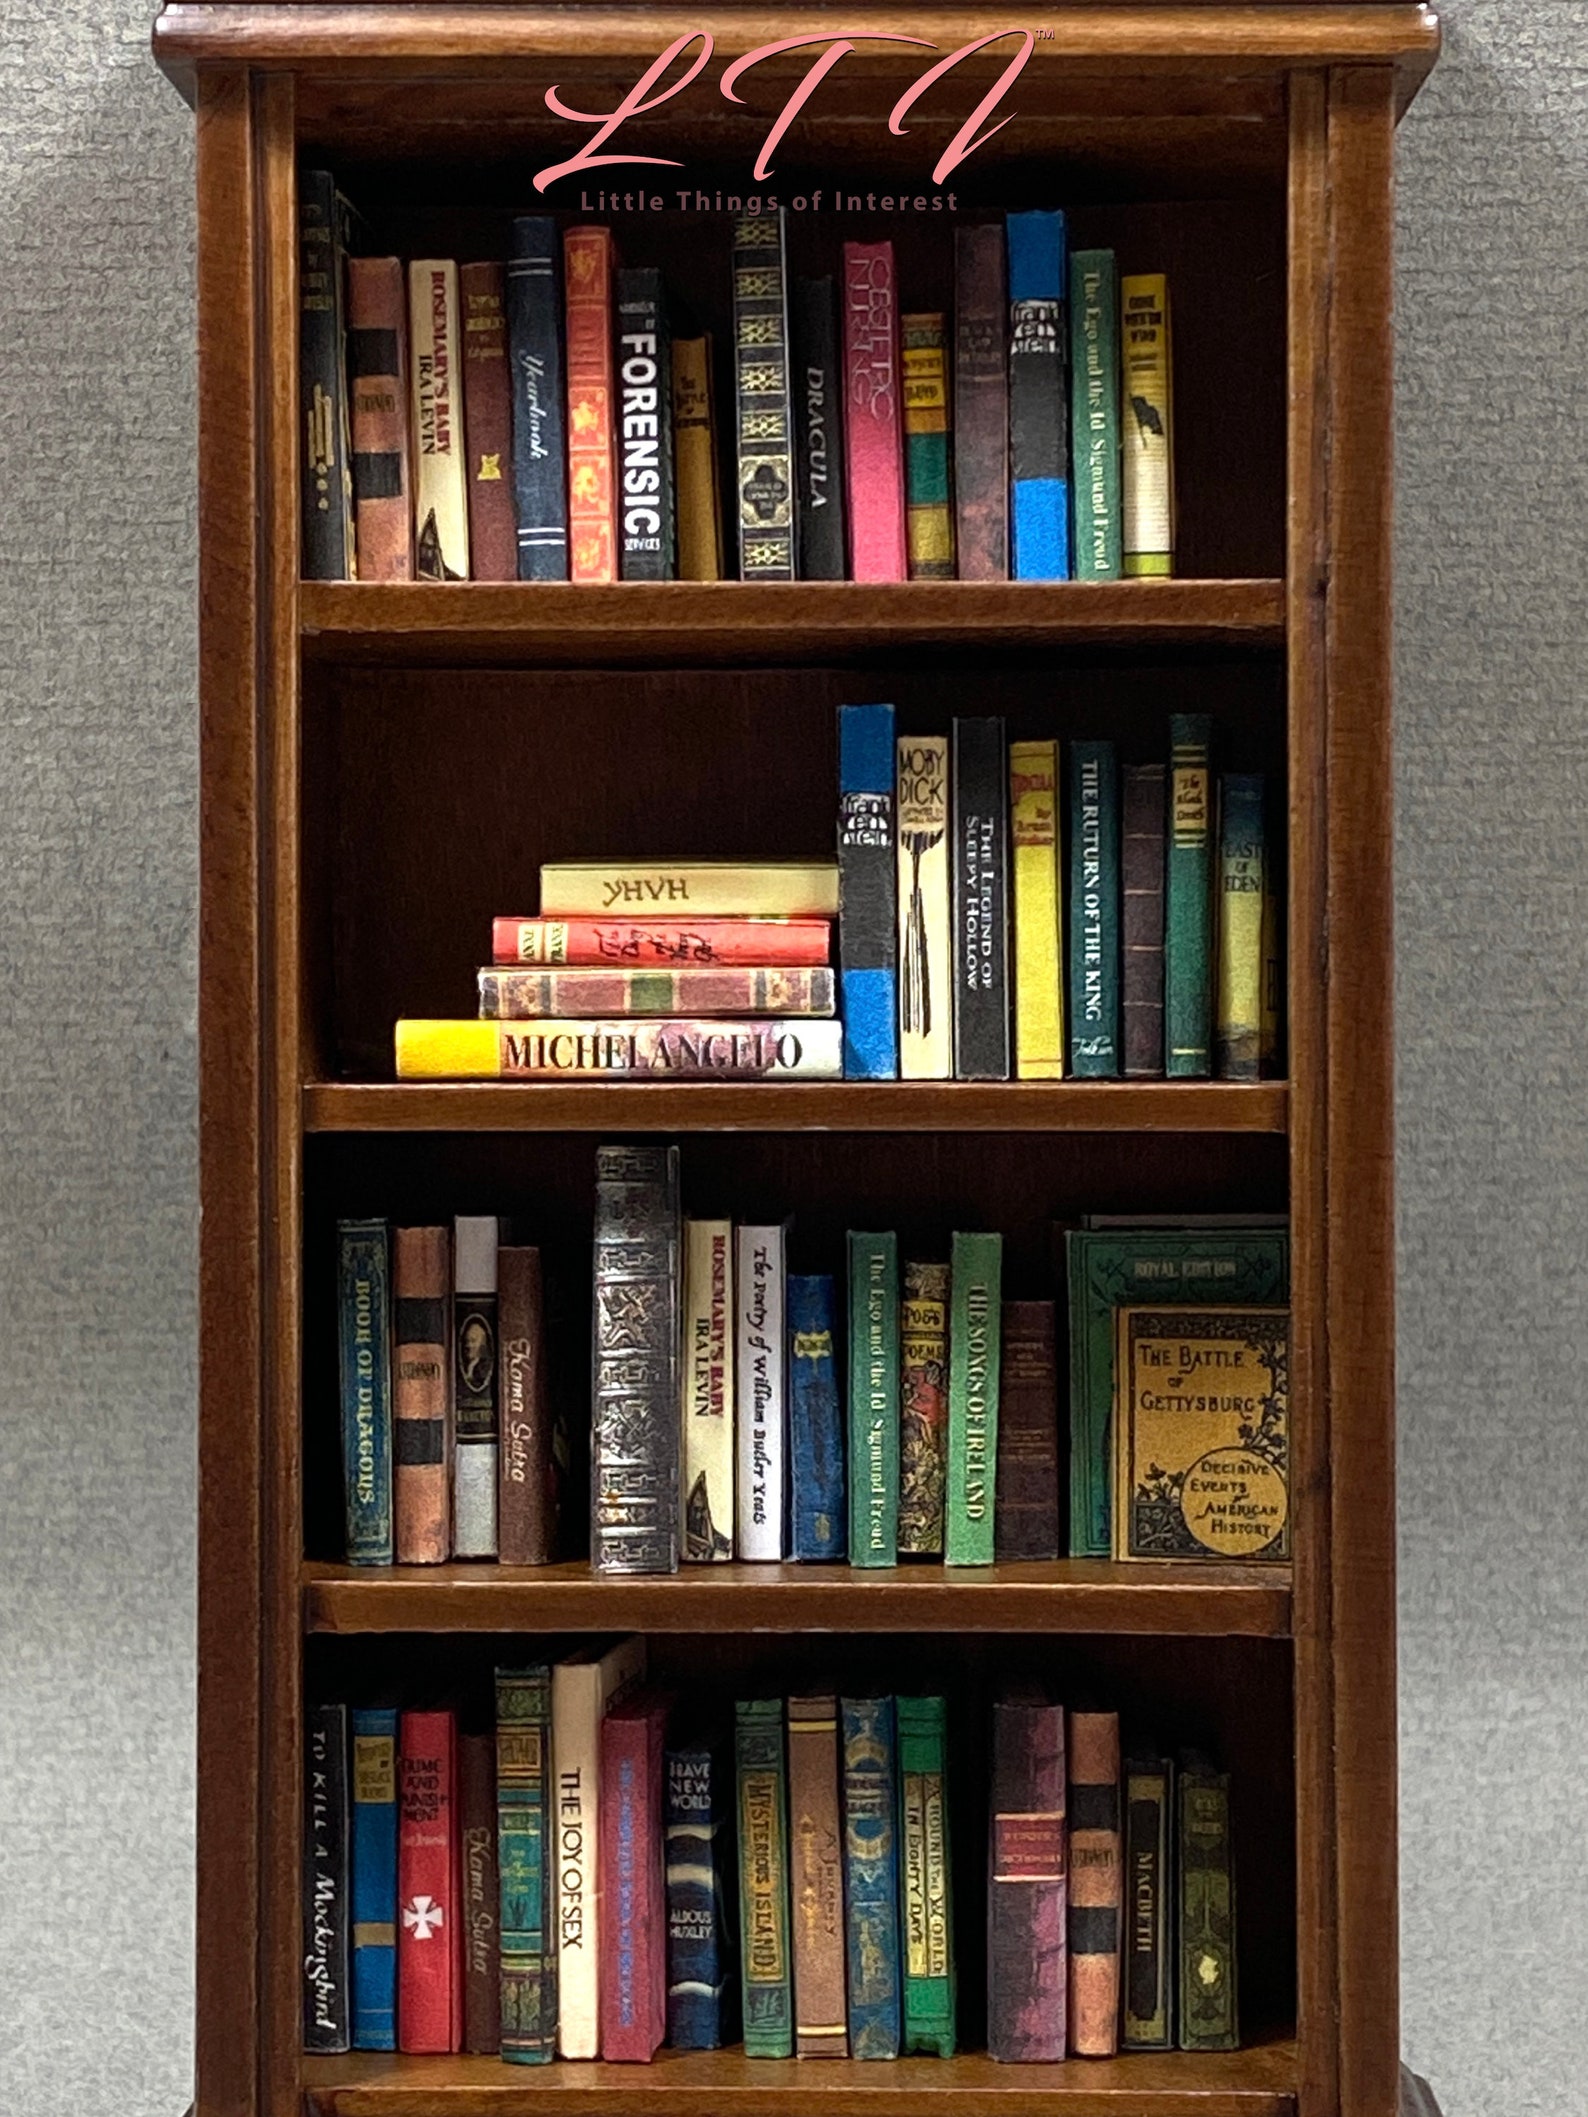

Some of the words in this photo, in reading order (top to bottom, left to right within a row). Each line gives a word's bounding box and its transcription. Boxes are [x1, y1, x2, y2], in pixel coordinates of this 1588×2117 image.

[1084, 272, 1100, 302] The
[1083, 307, 1100, 340] Ego
[418, 355, 432, 389] IRA
[1087, 344, 1103, 375] and
[1088, 380, 1104, 406] the
[420, 395, 435, 455] LEVIN
[621, 334, 661, 535] FORENSIC
[806, 367, 829, 509] DRACULA
[1090, 411, 1105, 430] Id
[1089, 438, 1110, 514] Sigmund
[1093, 518, 1111, 571] Freud
[900, 748, 944, 775] MOBY
[900, 777, 944, 805] DICK
[966, 815, 979, 889] SLEEPY
[981, 817, 994, 863] THE
[980, 871, 995, 957] LEGEND
[1084, 894, 1100, 920] OF
[966, 897, 980, 991] HOLLOW
[1084, 922, 1101, 965] THE
[981, 961, 993, 989] OF
[1085, 970, 1102, 1021] KING
[504, 1033, 802, 1069] MICHELANGELO
[754, 1246, 773, 1279] The
[870, 1254, 885, 1281] The
[1134, 1262, 1179, 1278] ROYAL
[355, 1279, 371, 1344] BOOK
[711, 1235, 726, 1361] ROSEMARY'S
[746, 1282, 767, 1332] Poetry
[868, 1288, 885, 1321] Ego
[968, 1282, 988, 1327] THE
[696, 1318, 710, 1351] IRA
[748, 1333, 772, 1353] of
[870, 1325, 886, 1356] and
[357, 1350, 374, 1380] OF
[508, 1338, 531, 1412] Kama
[870, 1360, 886, 1387] the
[967, 1327, 988, 1392] SONGS
[1138, 1344, 1171, 1367] THE
[1178, 1345, 1246, 1374] BATTLE
[694, 1357, 710, 1417] LEVIN
[710, 1365, 725, 1418] BABY
[753, 1355, 773, 1423] William
[870, 1392, 886, 1410] Id
[1140, 1390, 1256, 1420] GETTYSBURG
[966, 1396, 986, 1426] OF
[357, 1387, 375, 1504] DRAGONS
[511, 1419, 532, 1484] Sutra
[753, 1429, 772, 1479] Butler
[867, 1418, 886, 1493] Sigmund
[966, 1429, 986, 1519] IRELAND
[1190, 1478, 1247, 1493] EVENTS
[1201, 1459, 1270, 1475] DECISIVE
[753, 1483, 767, 1525] Yeats
[870, 1498, 886, 1549] Freud
[1194, 1501, 1279, 1520] AMERICAN
[1211, 1519, 1271, 1539] HISTORY
[313, 1731, 326, 1760] TO
[313, 1772, 328, 1829] KILL
[560, 1767, 581, 1816] THE
[669, 1780, 710, 1793] NEW
[669, 1795, 712, 1809] WORLD
[748, 1784, 771, 1884] MYSTERIOUS
[908, 1807, 920, 1826] IN
[315, 1843, 328, 1857] A
[562, 1822, 582, 1866] JOY
[562, 1869, 582, 1903] OF
[1137, 1851, 1154, 1951] MACBETH
[562, 1907, 582, 1949] SEX
[669, 1909, 712, 1924] ALDOUS
[669, 1925, 712, 1938] HUXLEY
[753, 1891, 776, 1967] ISLAND
[909, 1903, 924, 1944] DAYS
[929, 1897, 945, 1975] WORLD
[471, 1912, 493, 1975] Sutra
